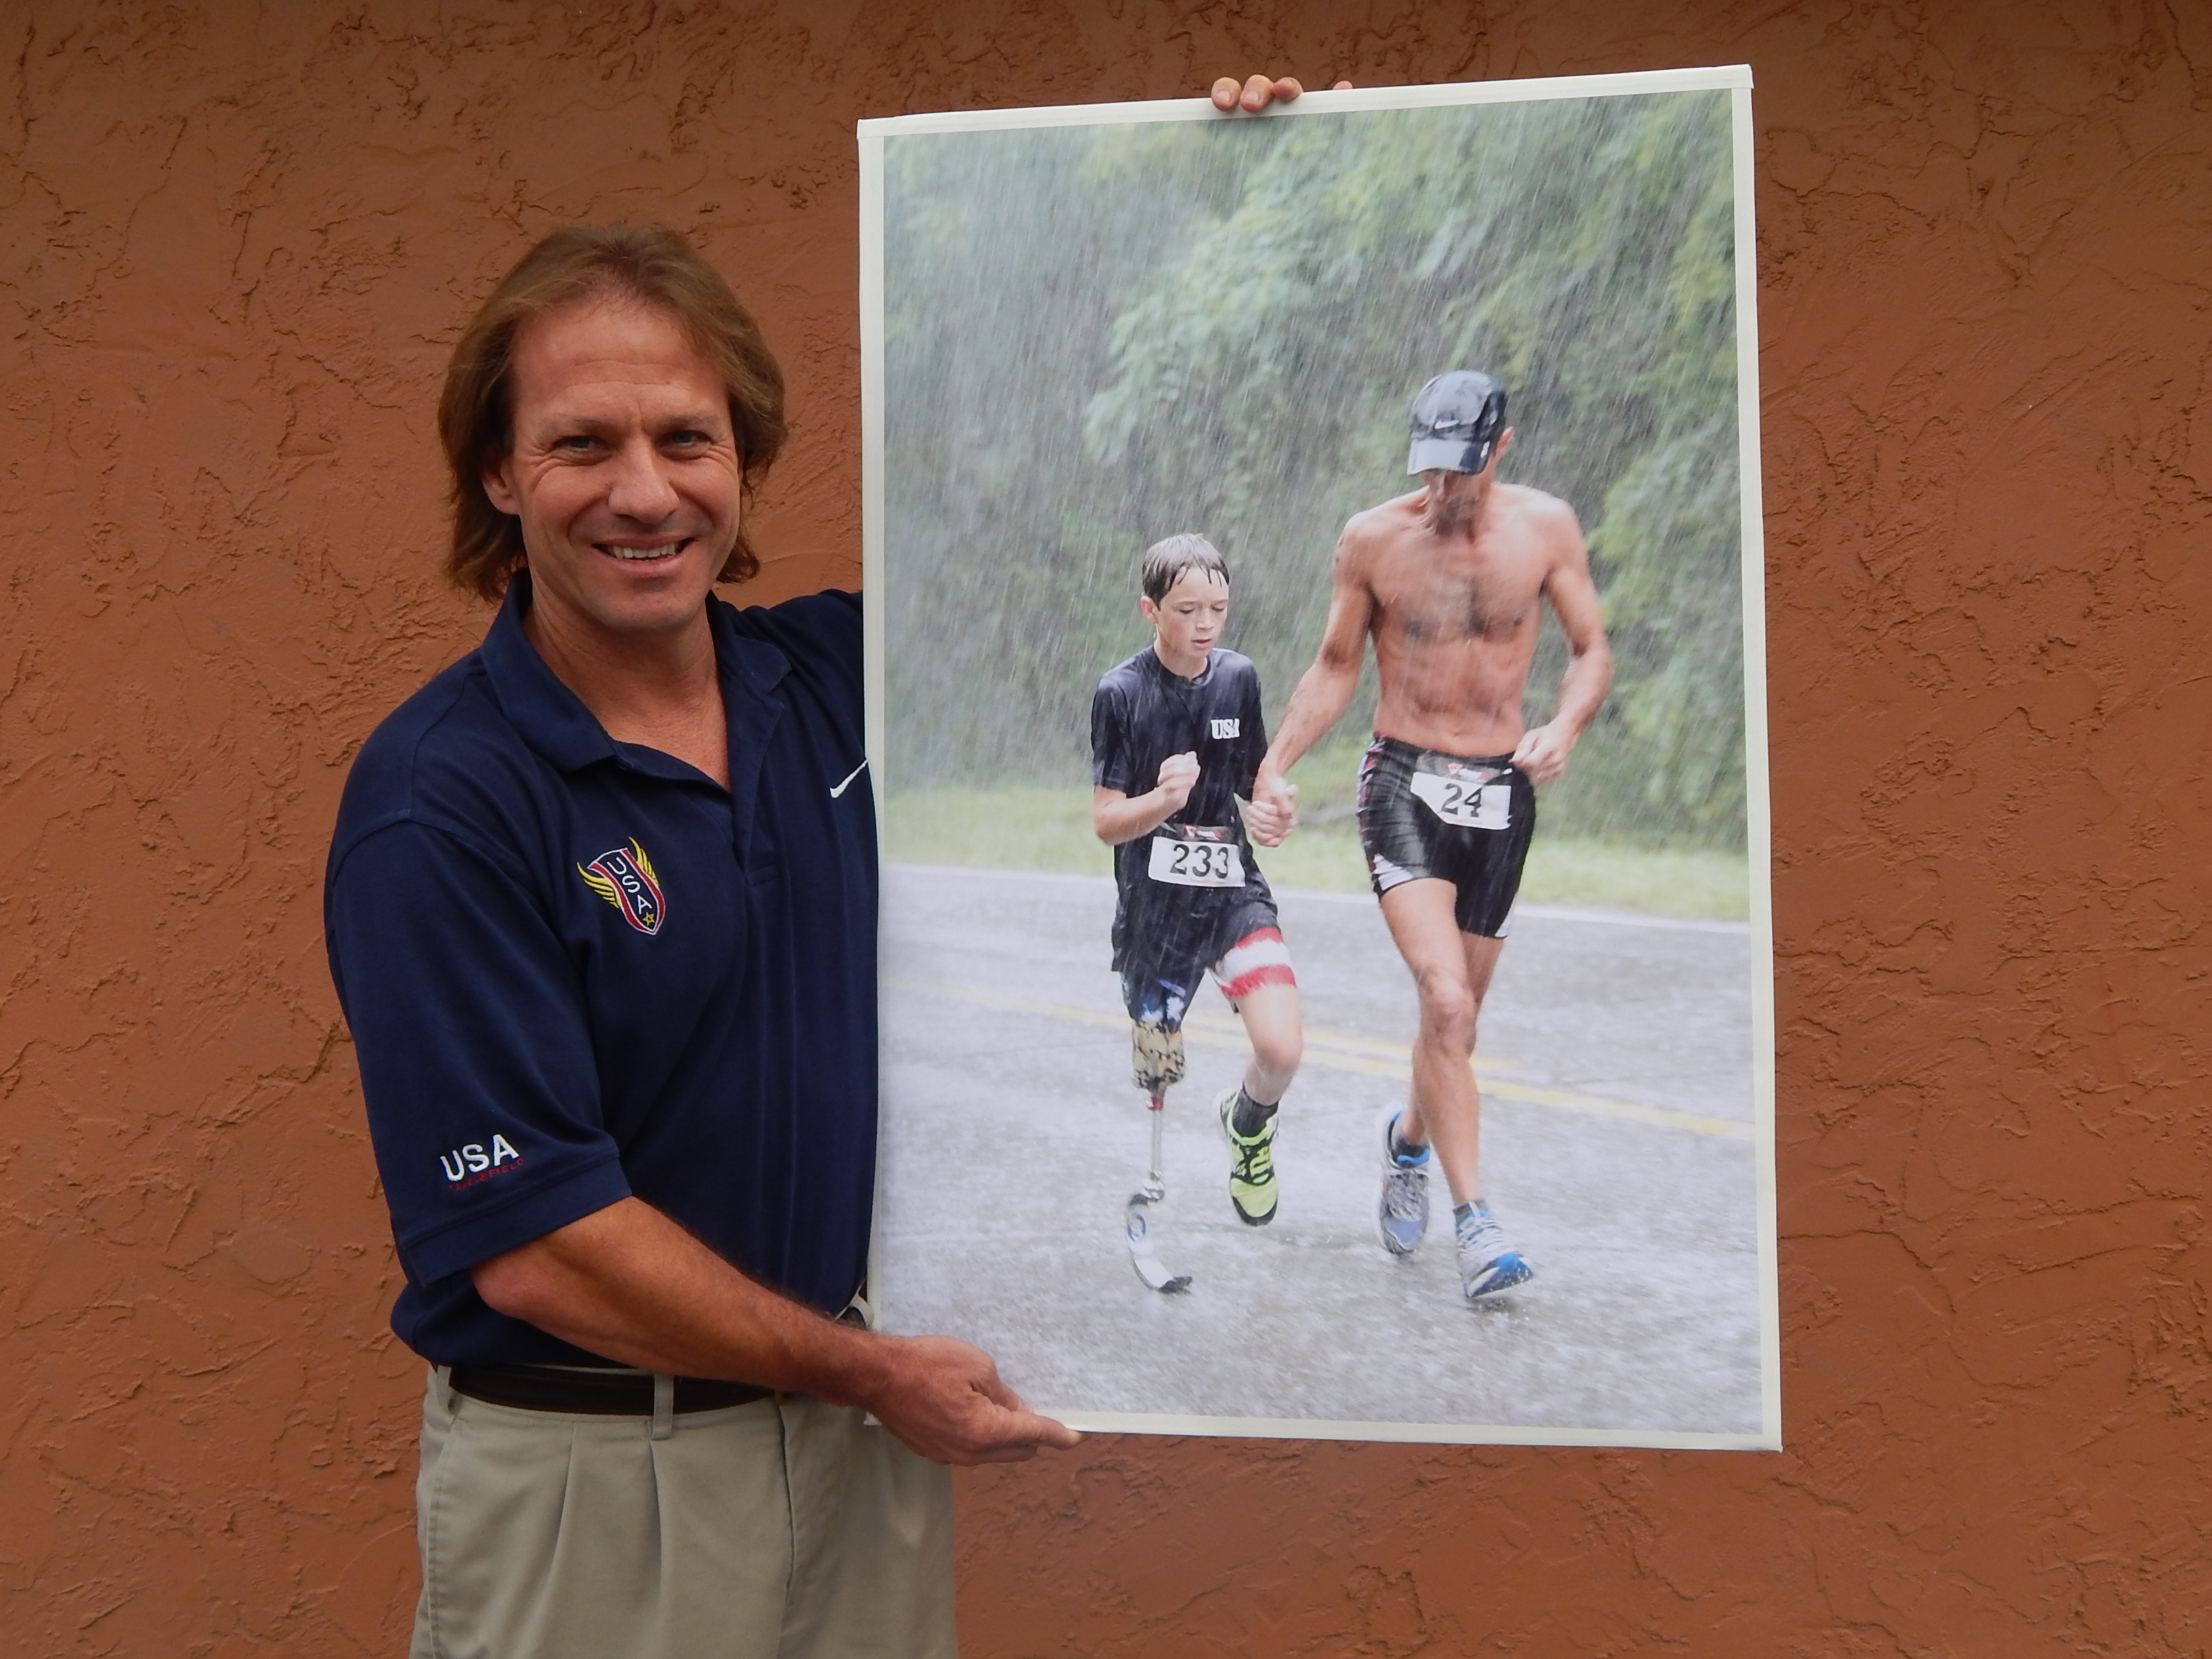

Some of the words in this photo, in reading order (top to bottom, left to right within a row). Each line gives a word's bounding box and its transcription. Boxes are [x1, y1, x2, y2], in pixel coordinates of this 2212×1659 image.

[1441, 783, 1482, 818] 24
[1170, 844, 1229, 879] 233
[607, 857, 653, 915] USA
[440, 1134, 520, 1181] USA
